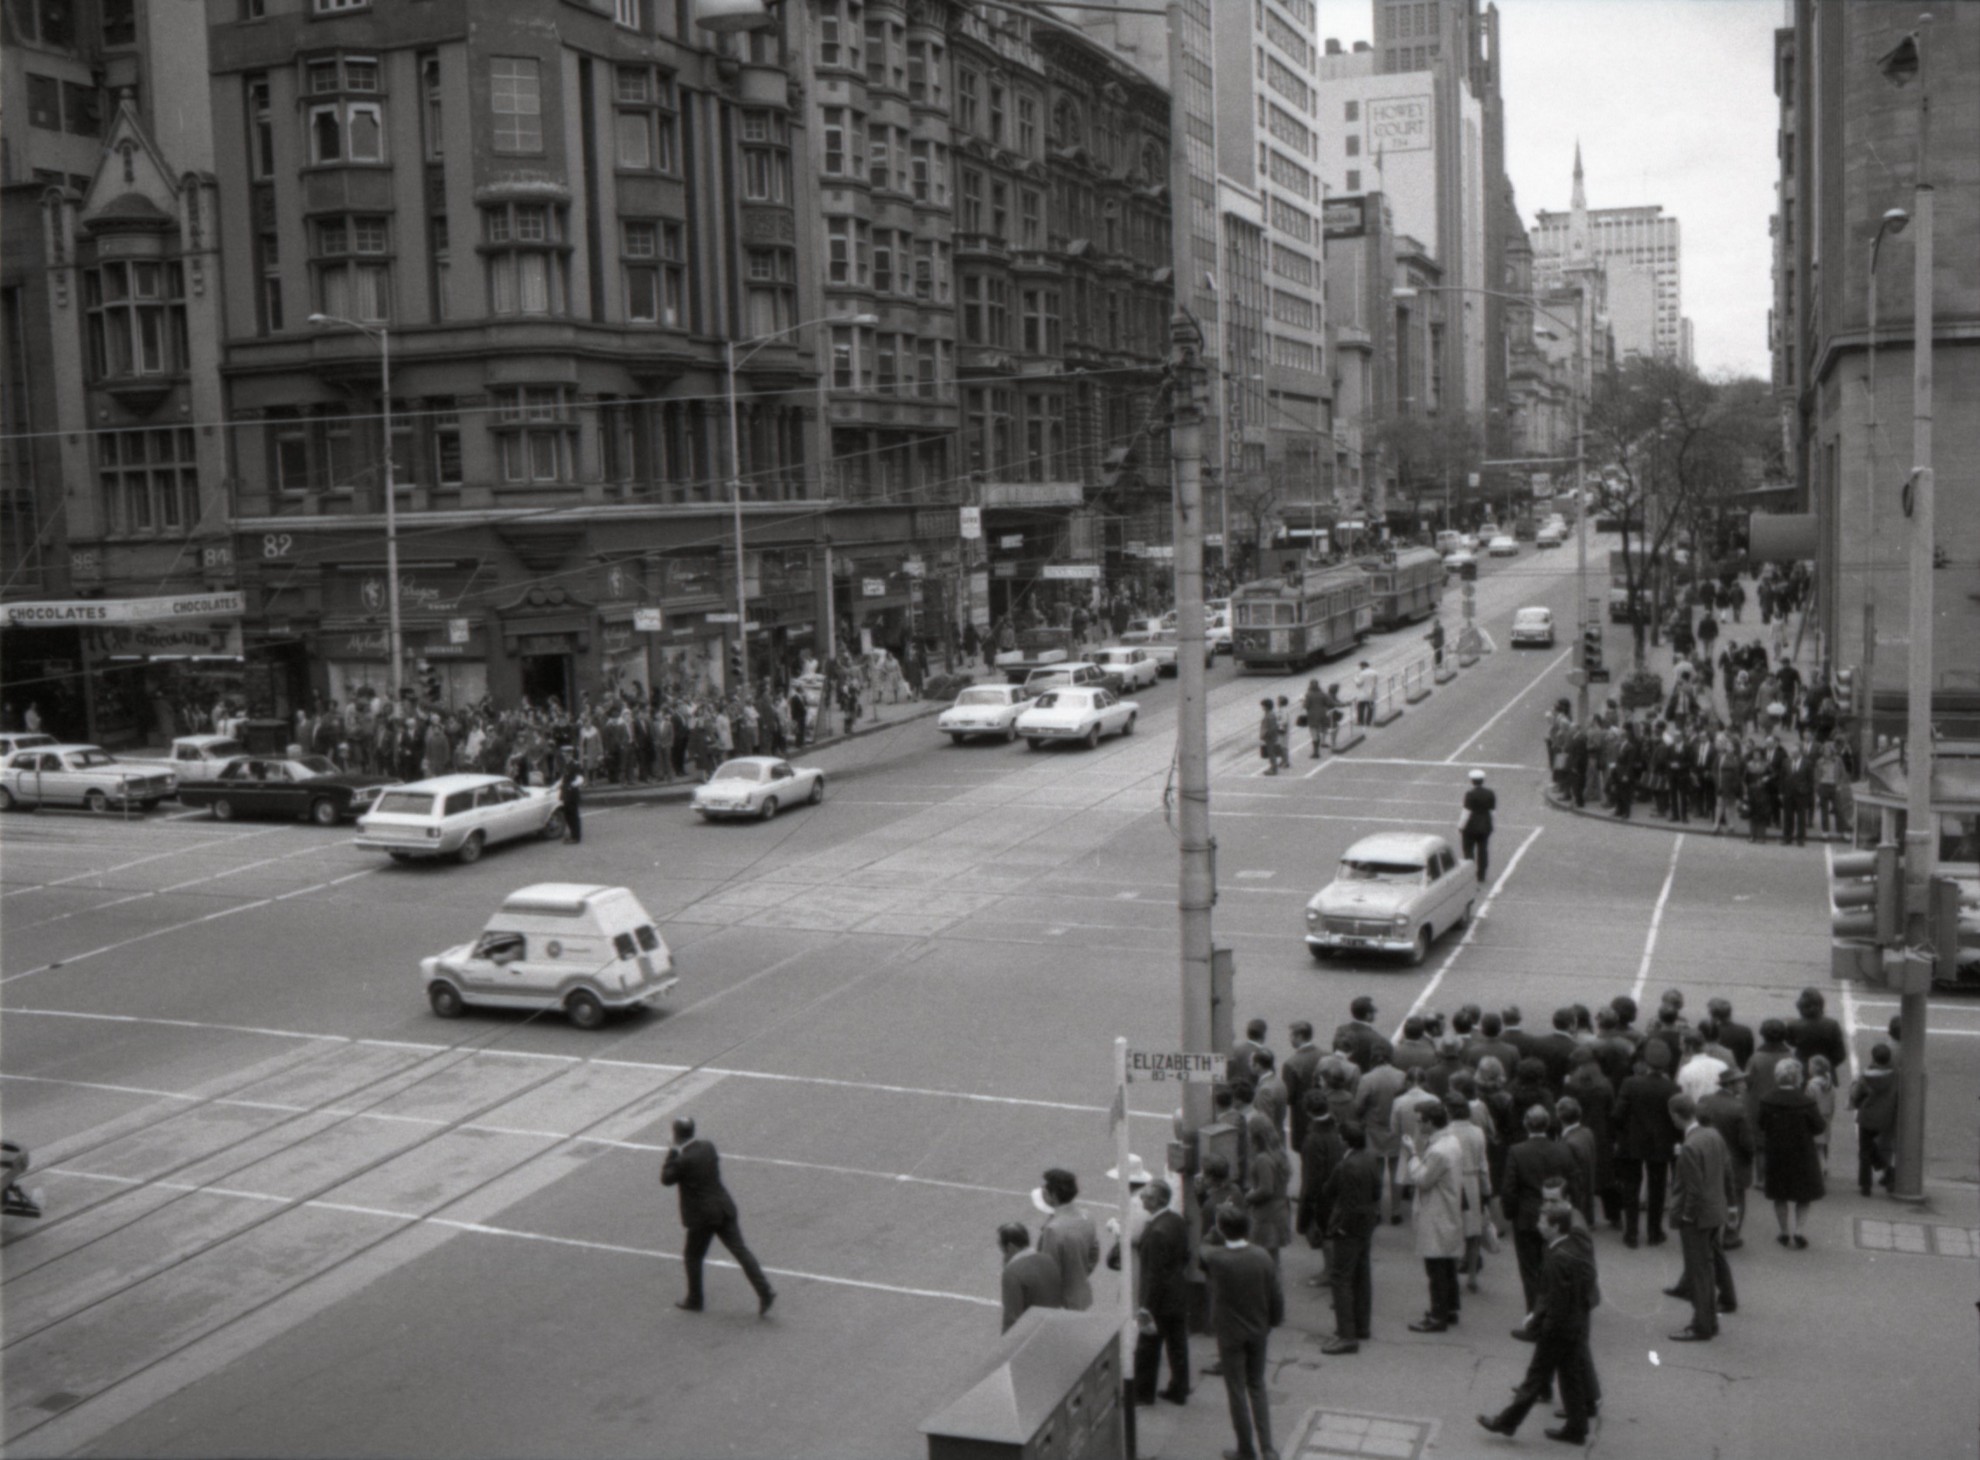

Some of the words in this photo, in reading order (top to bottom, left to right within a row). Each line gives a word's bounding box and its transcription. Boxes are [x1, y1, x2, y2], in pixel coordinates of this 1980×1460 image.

[1373, 103, 1423, 121] HOWEY
[1373, 120, 1425, 138] COURT
[263, 533, 293, 559] 82
[8, 606, 107, 620] CHOCOLATES
[172, 597, 239, 614] CHOCOLATES
[1133, 1052, 1211, 1071] ELIZABETH
